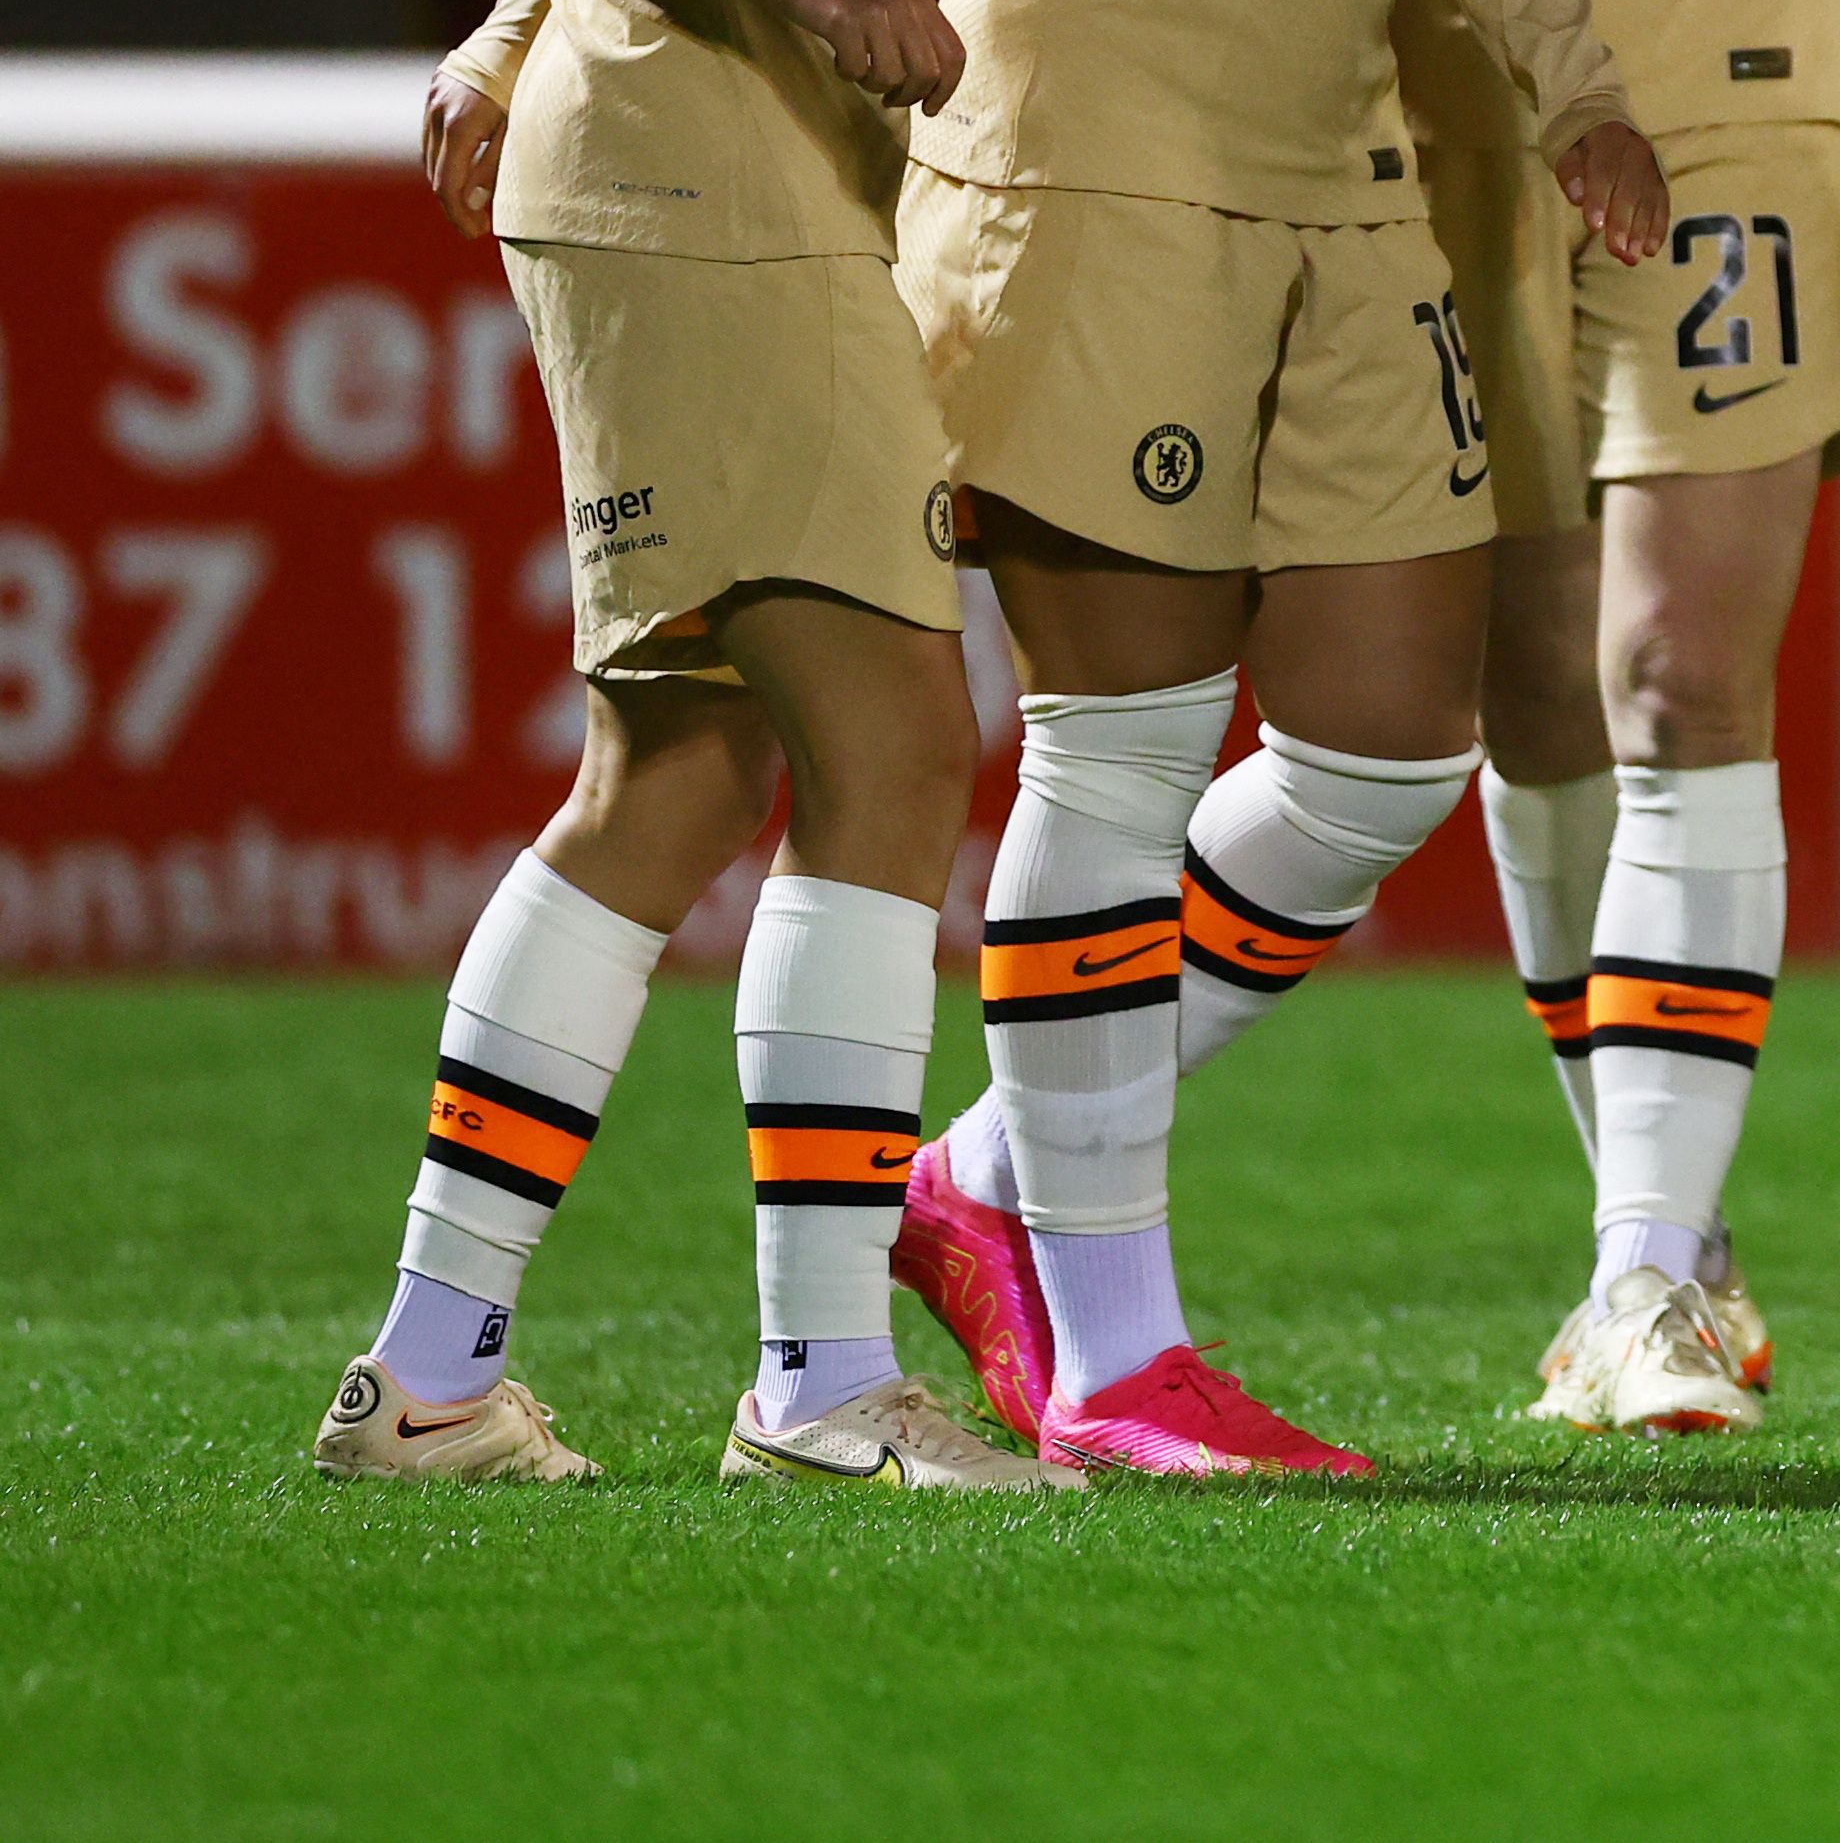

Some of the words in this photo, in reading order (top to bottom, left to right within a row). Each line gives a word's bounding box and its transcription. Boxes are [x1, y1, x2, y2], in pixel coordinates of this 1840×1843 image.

[1670, 213, 1800, 368] 21
[603, 532, 668, 559] Markets
[431, 1098, 485, 1131] CFC
